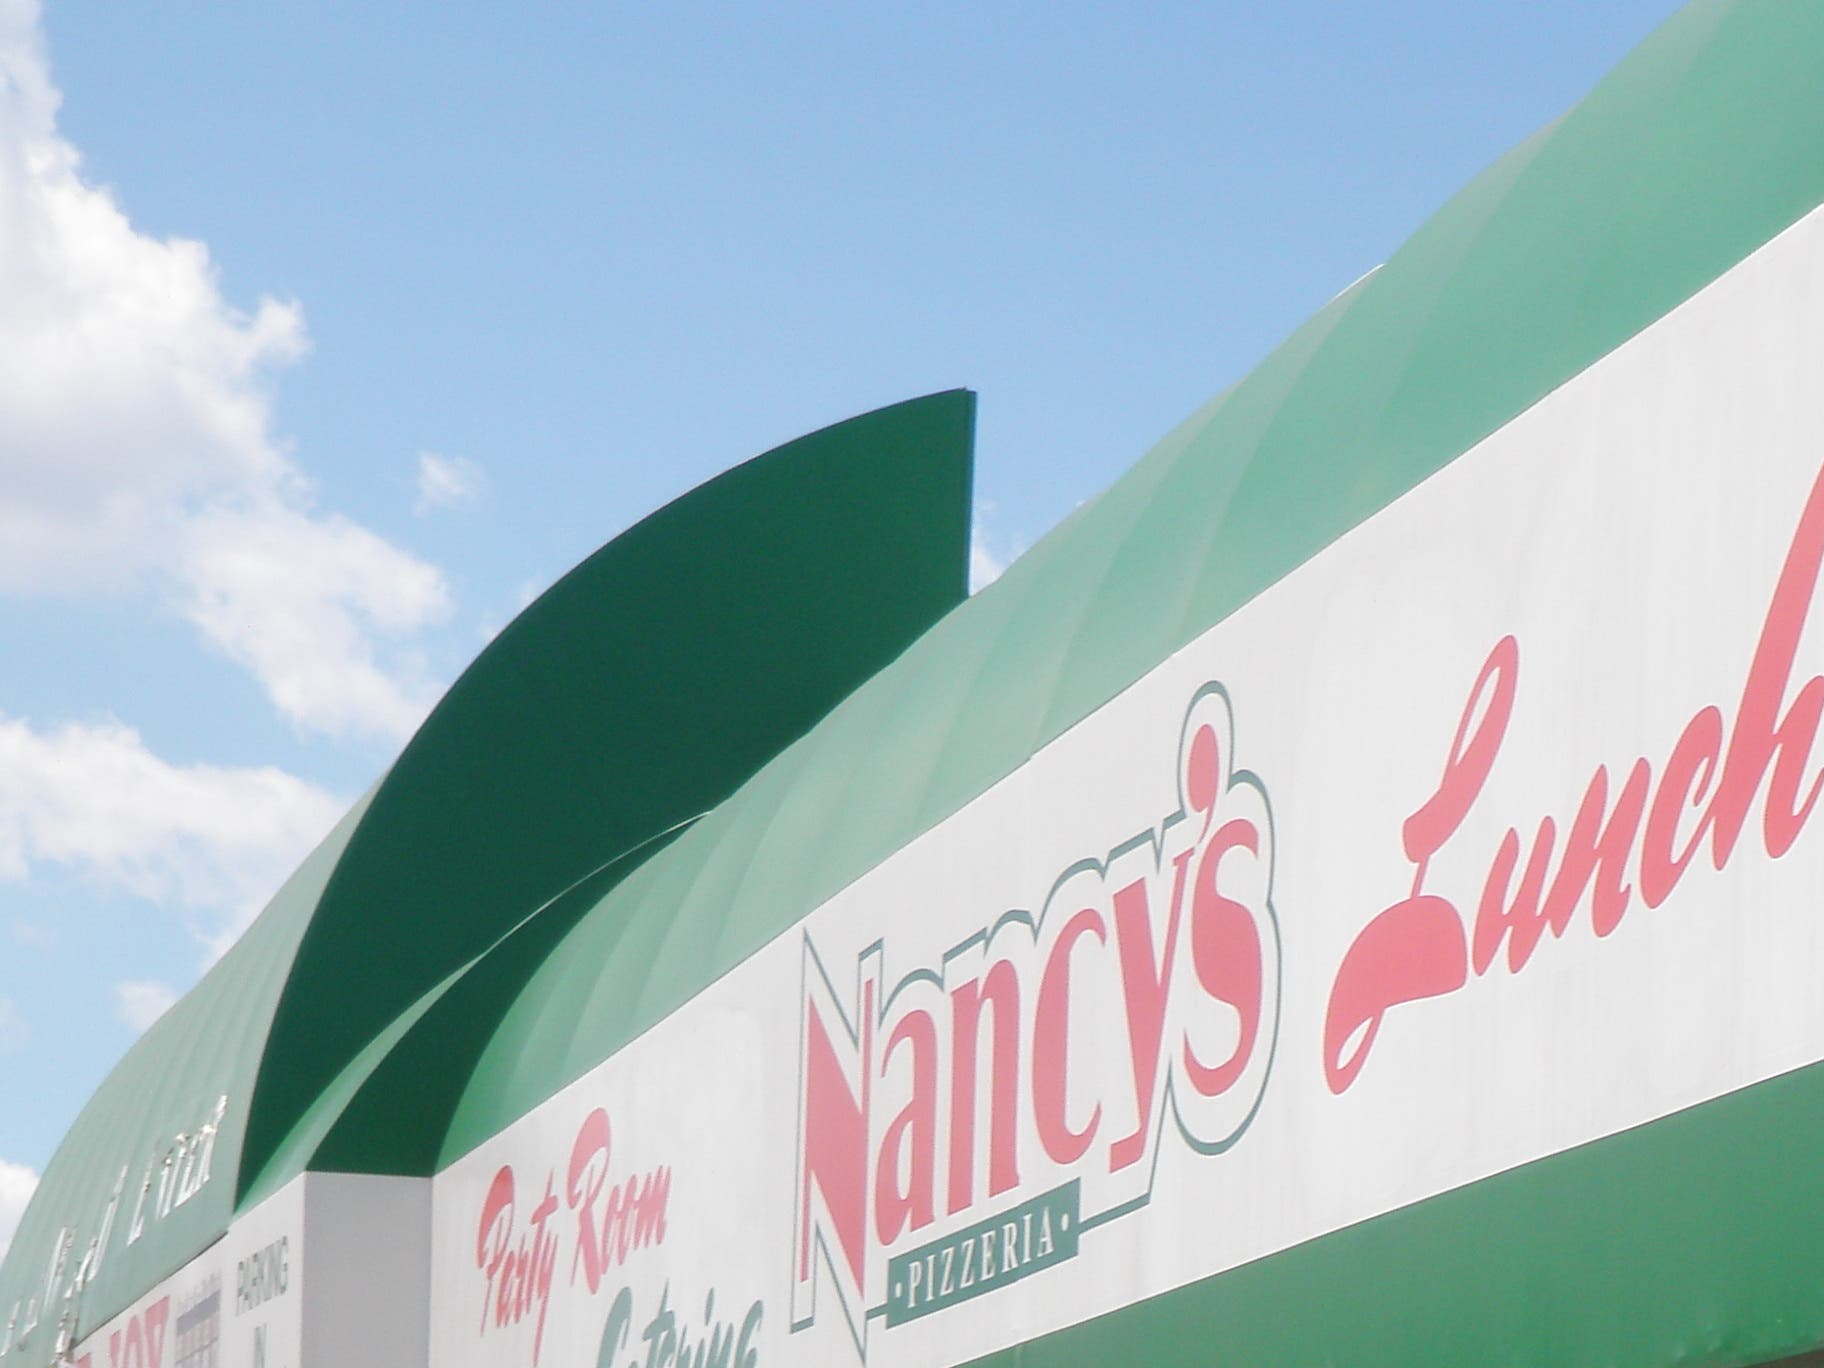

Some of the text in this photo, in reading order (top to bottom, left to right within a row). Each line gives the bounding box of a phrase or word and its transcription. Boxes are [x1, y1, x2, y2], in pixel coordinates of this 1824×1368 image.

[799, 724, 1262, 1300] Nancy's
[235, 1236, 288, 1317] PARKING
[477, 1107, 671, 1368] Party Room
[906, 1206, 1055, 1308] PIZZERIA
